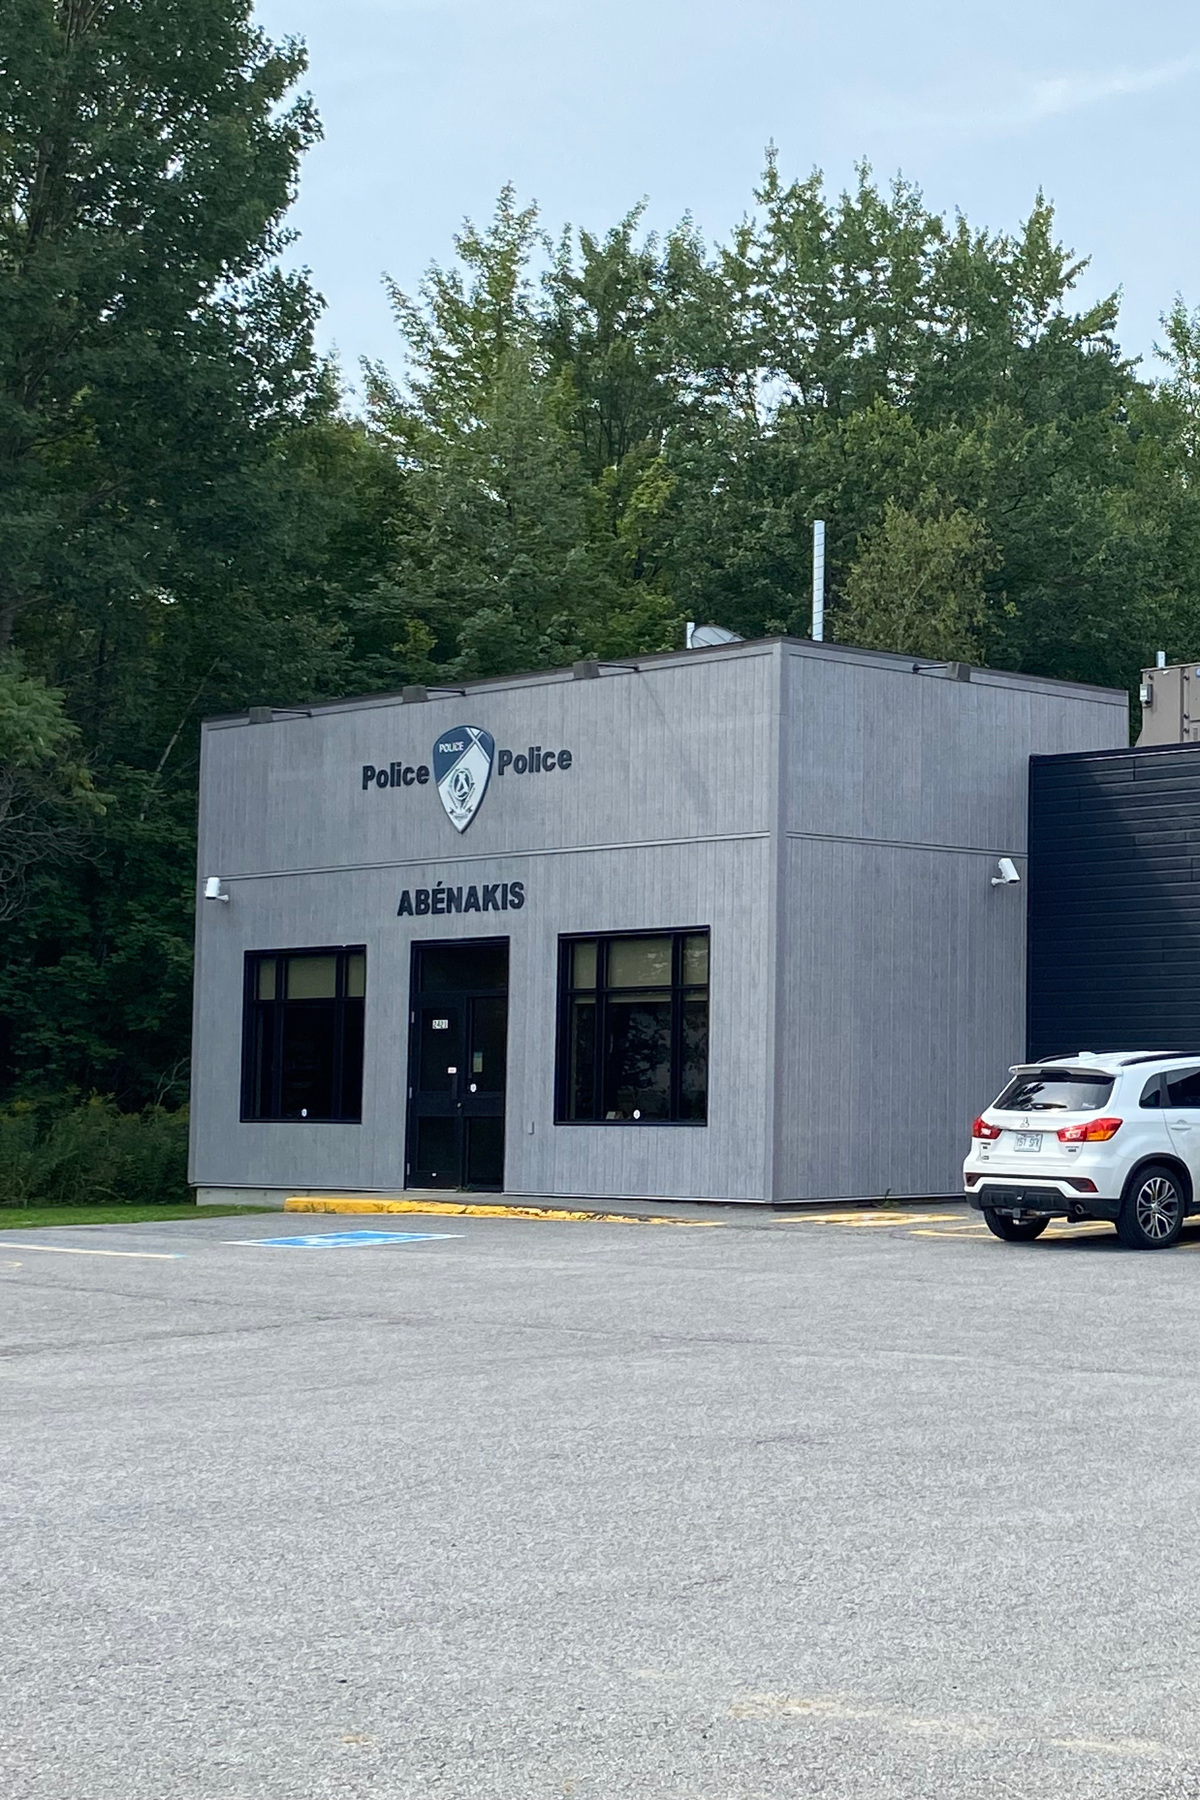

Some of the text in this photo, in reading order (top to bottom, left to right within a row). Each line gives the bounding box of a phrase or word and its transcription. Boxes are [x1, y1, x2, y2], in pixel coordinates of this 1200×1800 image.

[438, 741, 465, 754] POLICE
[498, 746, 573, 776] Police
[362, 762, 430, 790] Police
[397, 881, 525, 916] ABÉNAKIS
